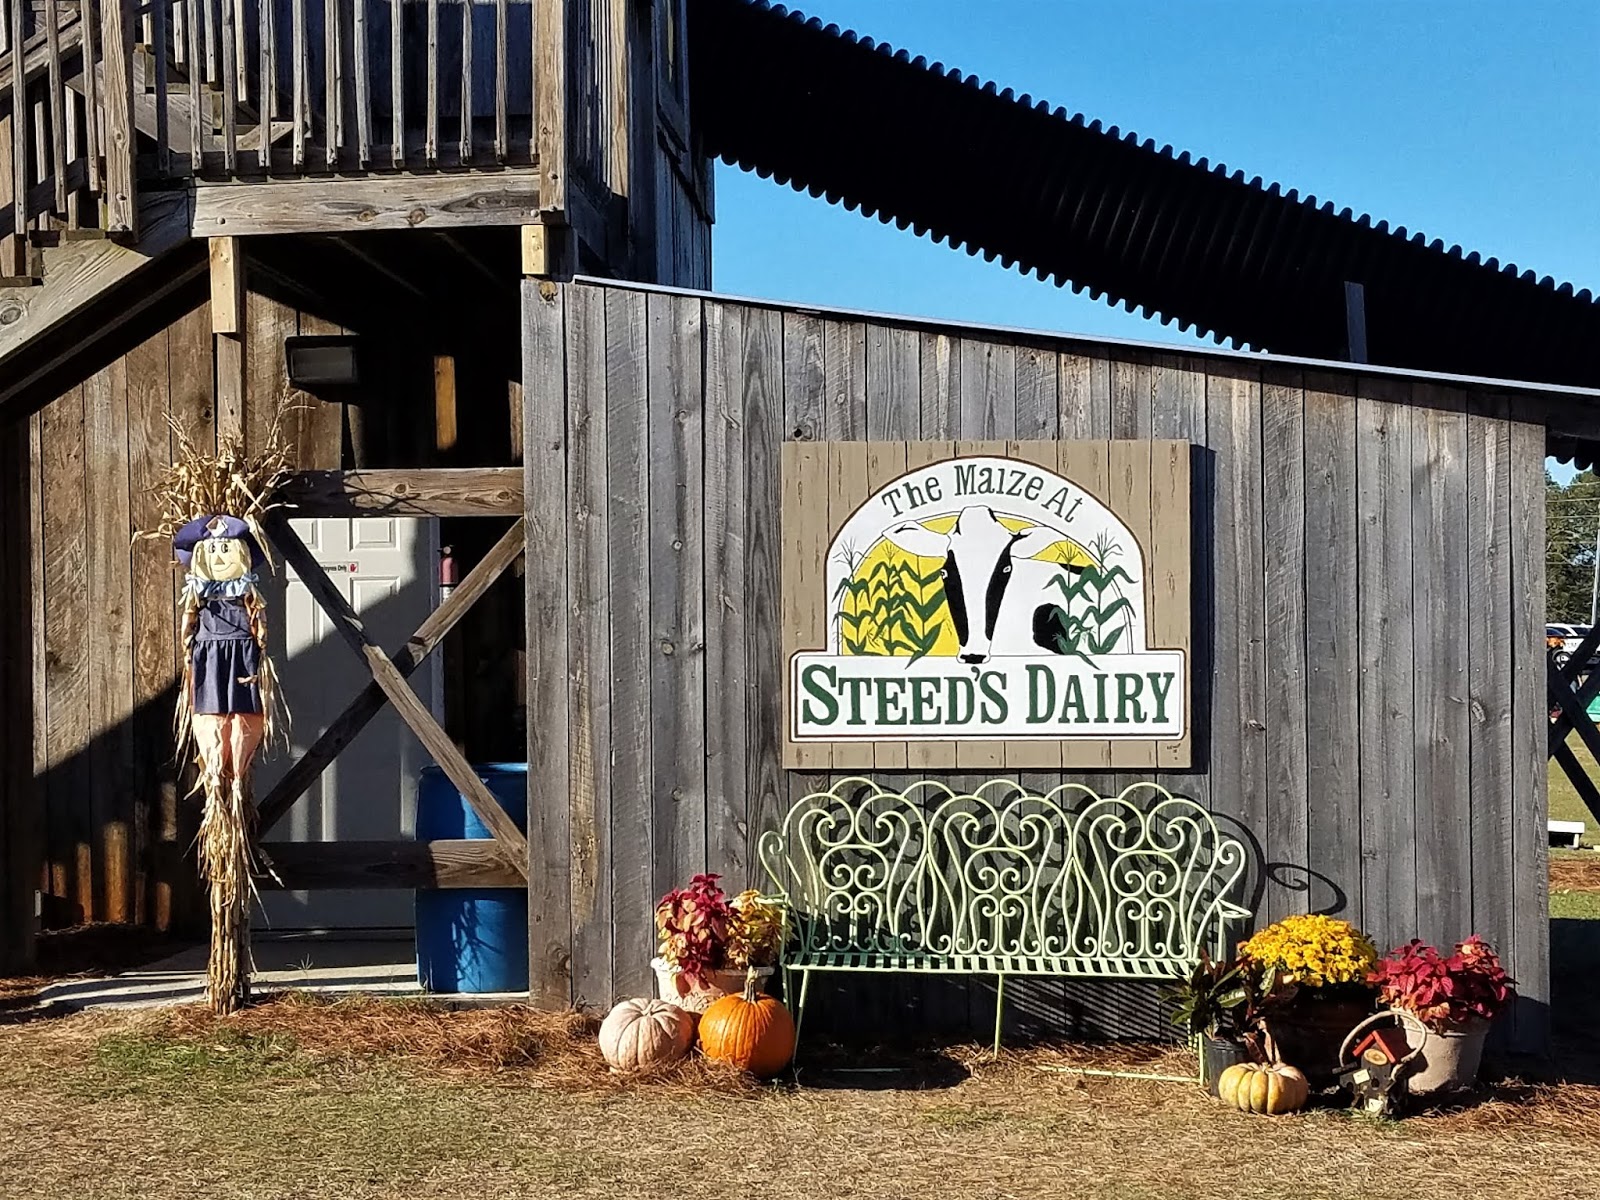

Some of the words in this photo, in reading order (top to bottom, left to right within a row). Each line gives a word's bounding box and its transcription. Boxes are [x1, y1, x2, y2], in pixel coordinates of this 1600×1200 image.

[881, 476, 943, 518] The
[954, 464, 1045, 501] Maize
[1041, 486, 1083, 523] At
[801, 664, 1009, 726] STEED'S
[1025, 663, 1176, 724] DAIRY
